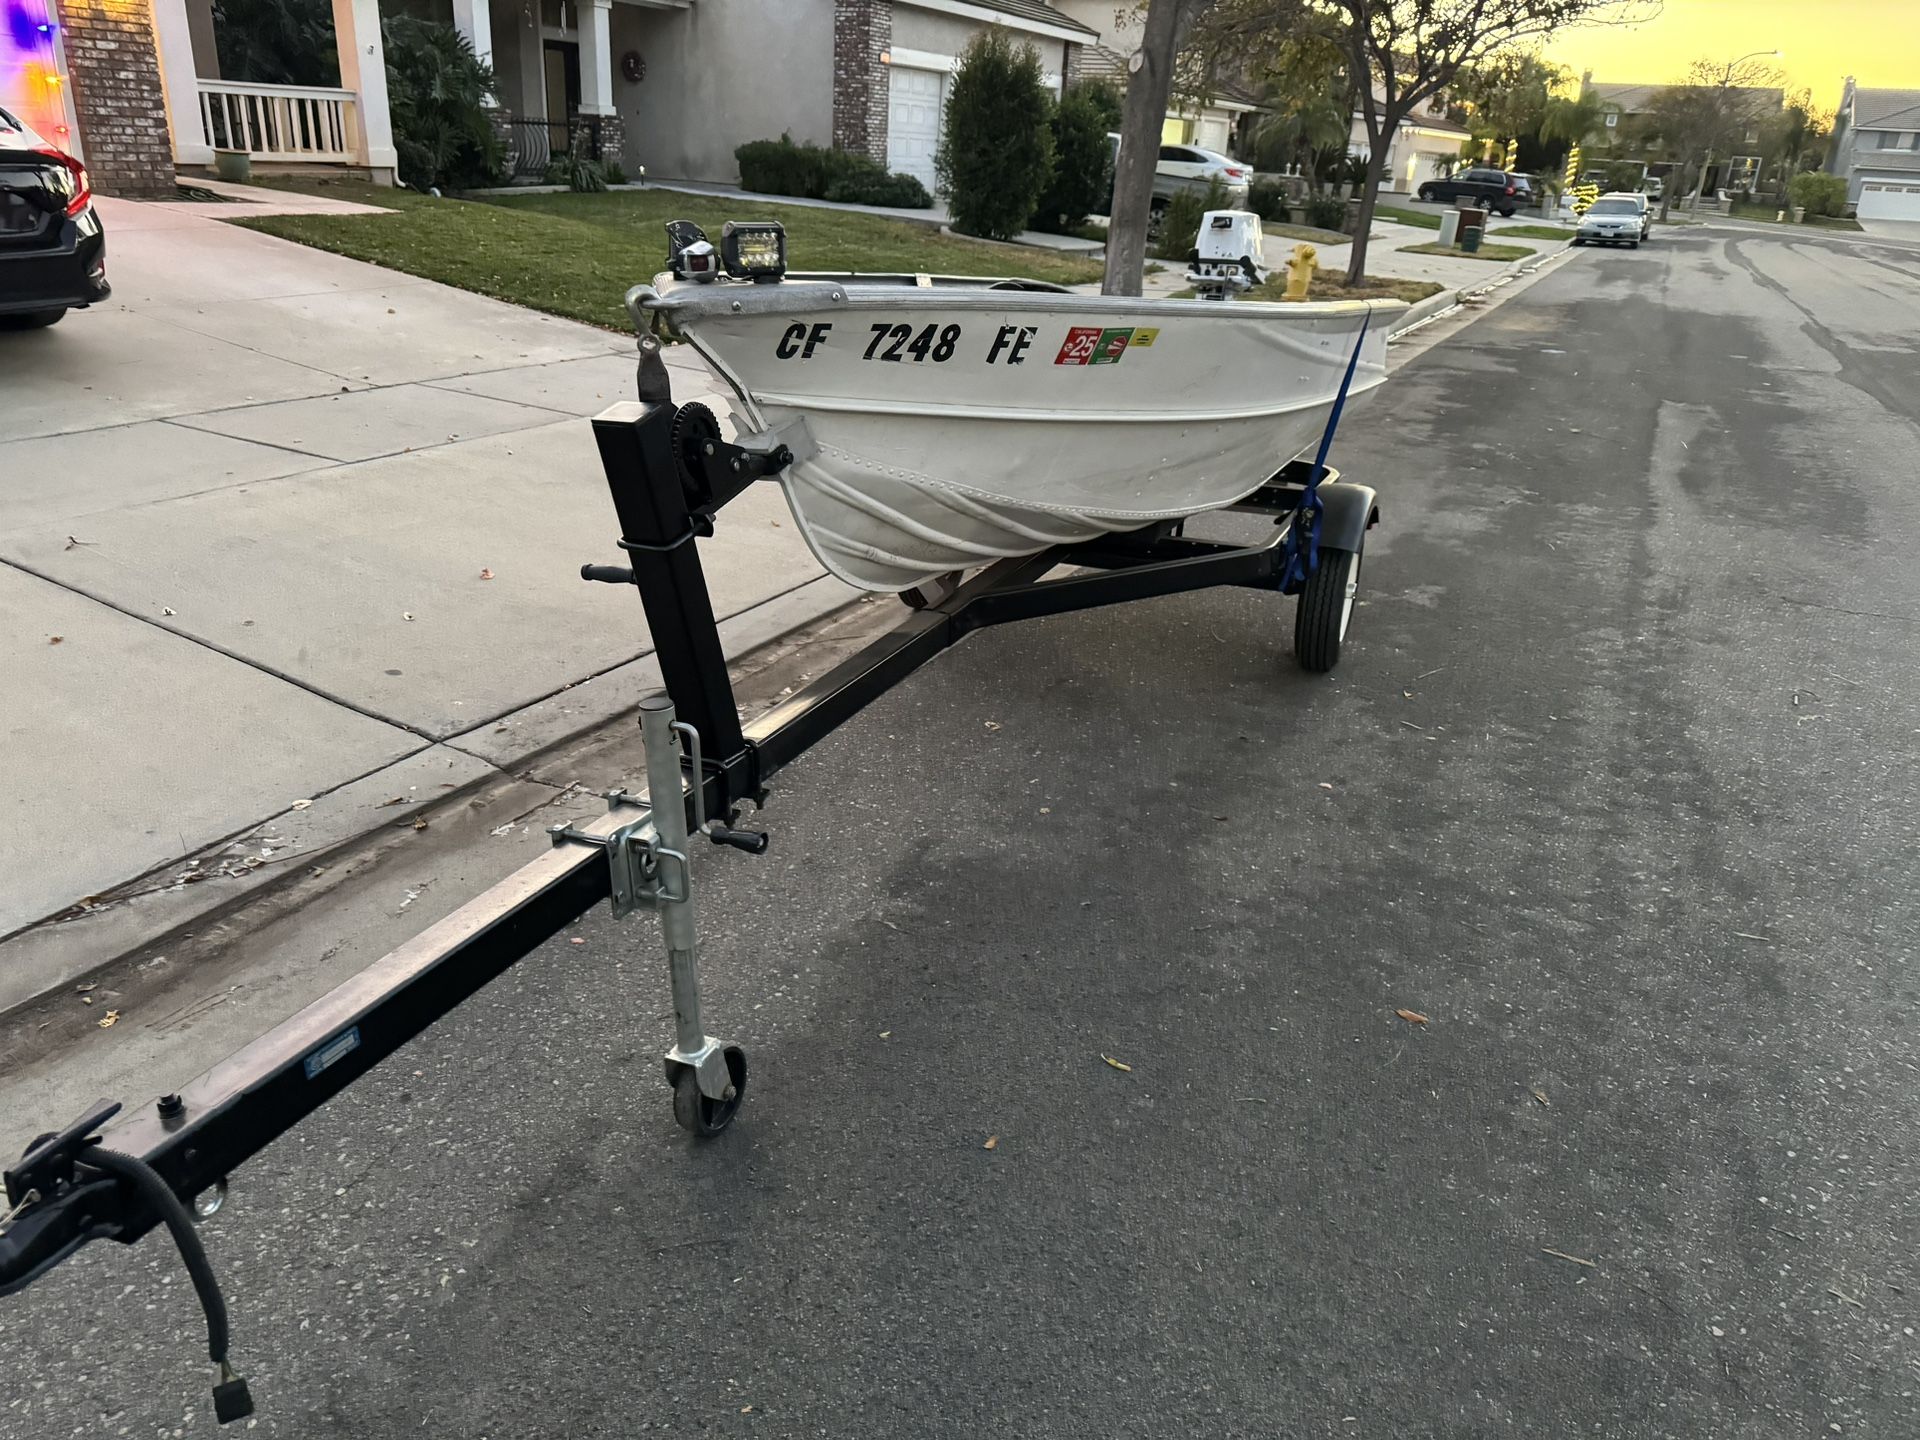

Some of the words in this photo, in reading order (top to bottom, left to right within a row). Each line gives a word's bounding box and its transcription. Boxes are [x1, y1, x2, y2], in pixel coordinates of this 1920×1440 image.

[776, 323, 832, 359] CF
[862, 323, 961, 362] 7248
[986, 326, 1038, 364] FE
[1069, 335, 1098, 357] 25
